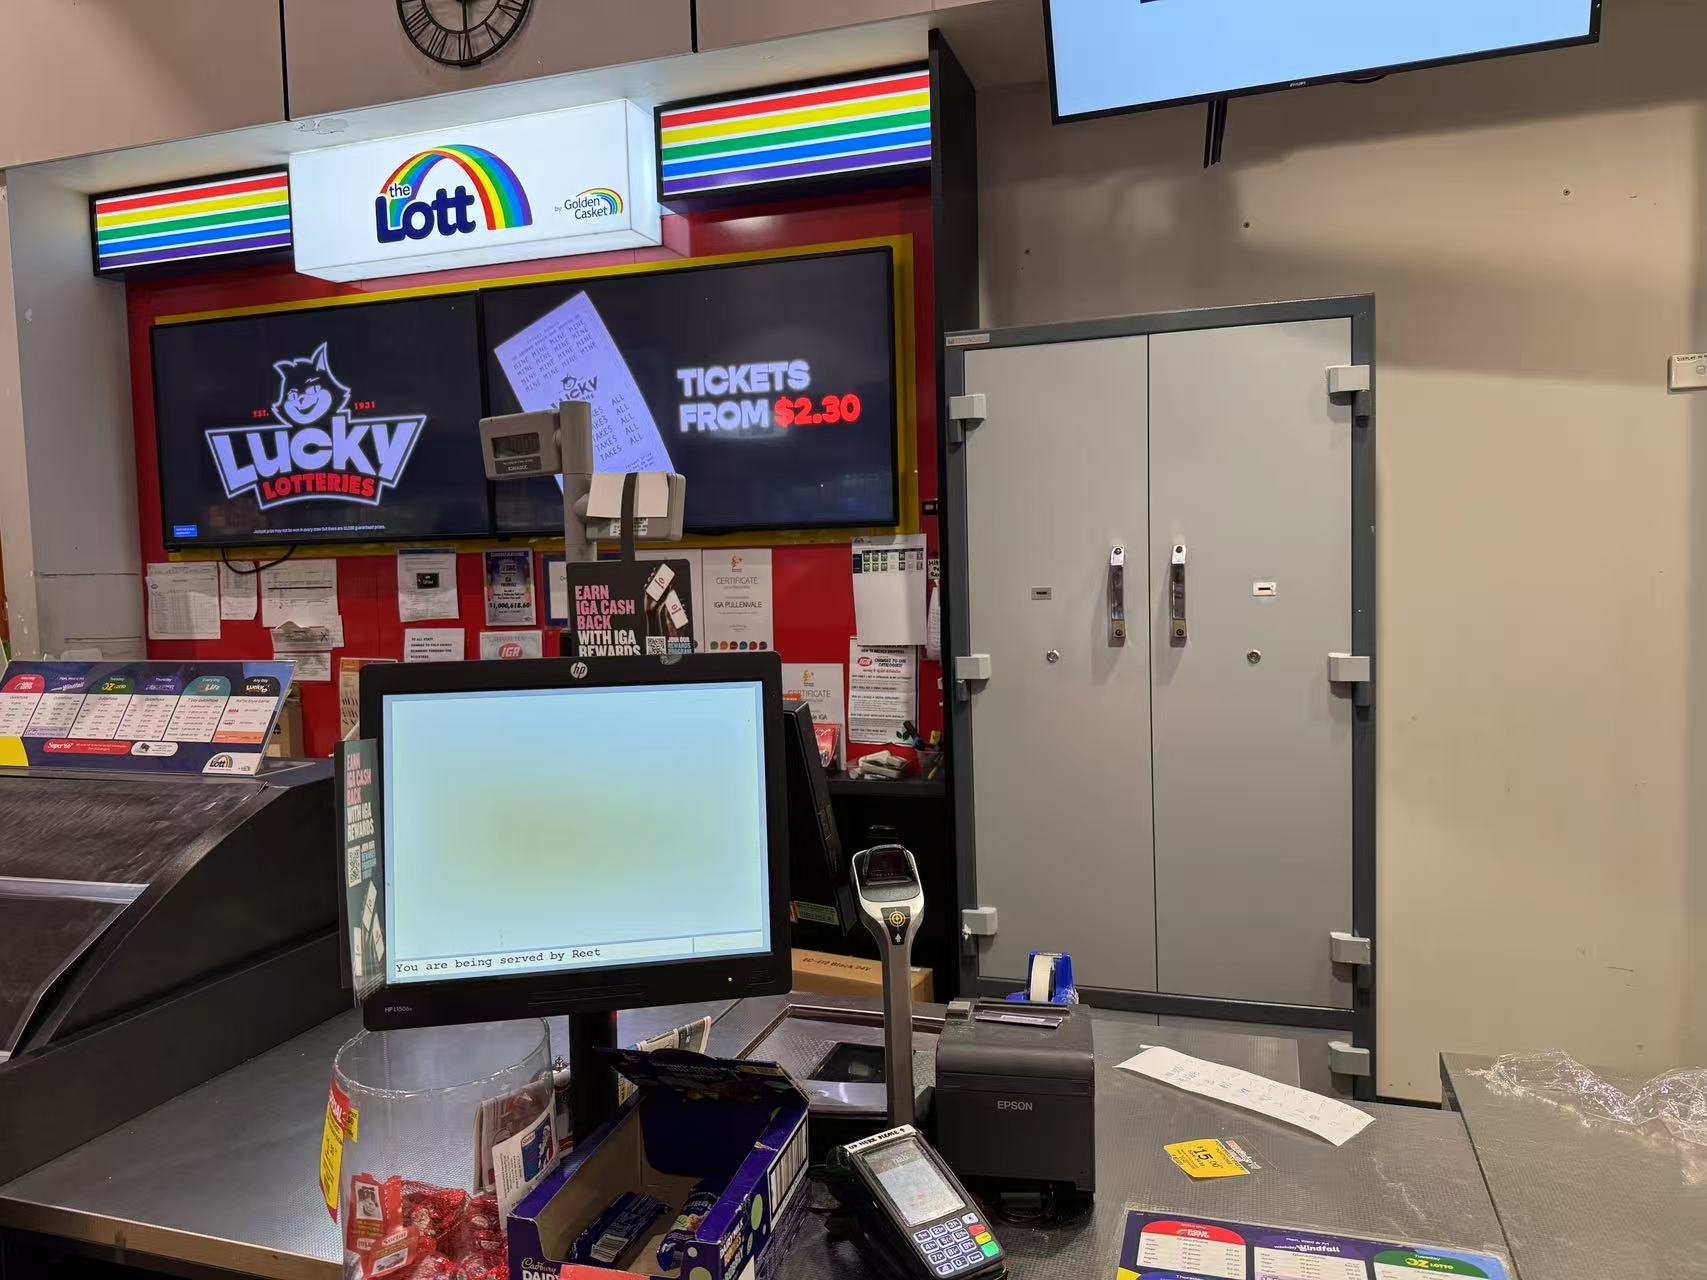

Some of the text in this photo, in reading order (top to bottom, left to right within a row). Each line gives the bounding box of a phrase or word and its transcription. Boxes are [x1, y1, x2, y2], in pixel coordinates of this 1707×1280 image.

[389, 183, 410, 198] the
[564, 196, 600, 210] Golden
[375, 186, 476, 243] Lott
[575, 206, 608, 220] Casket
[677, 360, 810, 396] TICKETS
[611, 392, 625, 406] ALL
[252, 401, 376, 418] EST. 1931
[616, 402, 630, 416] ALL
[680, 393, 861, 432] FROM $2.30
[621, 412, 635, 425] ALL
[626, 422, 640, 436] ALL
[600, 432, 644, 462] TAKES ALL
[262, 473, 376, 500] LOTTERIES
[716, 576, 758, 584] CERTIFICATE
[575, 585, 609, 600] EARN
[576, 600, 635, 615] IGA CASH
[577, 615, 612, 630] BACK
[578, 630, 636, 645] WITH IGA
[502, 647, 520, 657] IGA
[578, 645, 641, 657] REWARDS
[572, 662, 588, 678] hp
[396, 949, 600, 973] You are being served by Reet
[998, 1100, 1033, 1111] EPSON
[859, 1137, 877, 1146] HERE
[878, 1130, 899, 1140] PLEASE
[1296, 1244, 1340, 1252] Windfall
[521, 1257, 556, 1274] Cadbury
[1405, 1258, 1429, 1268] OZ
